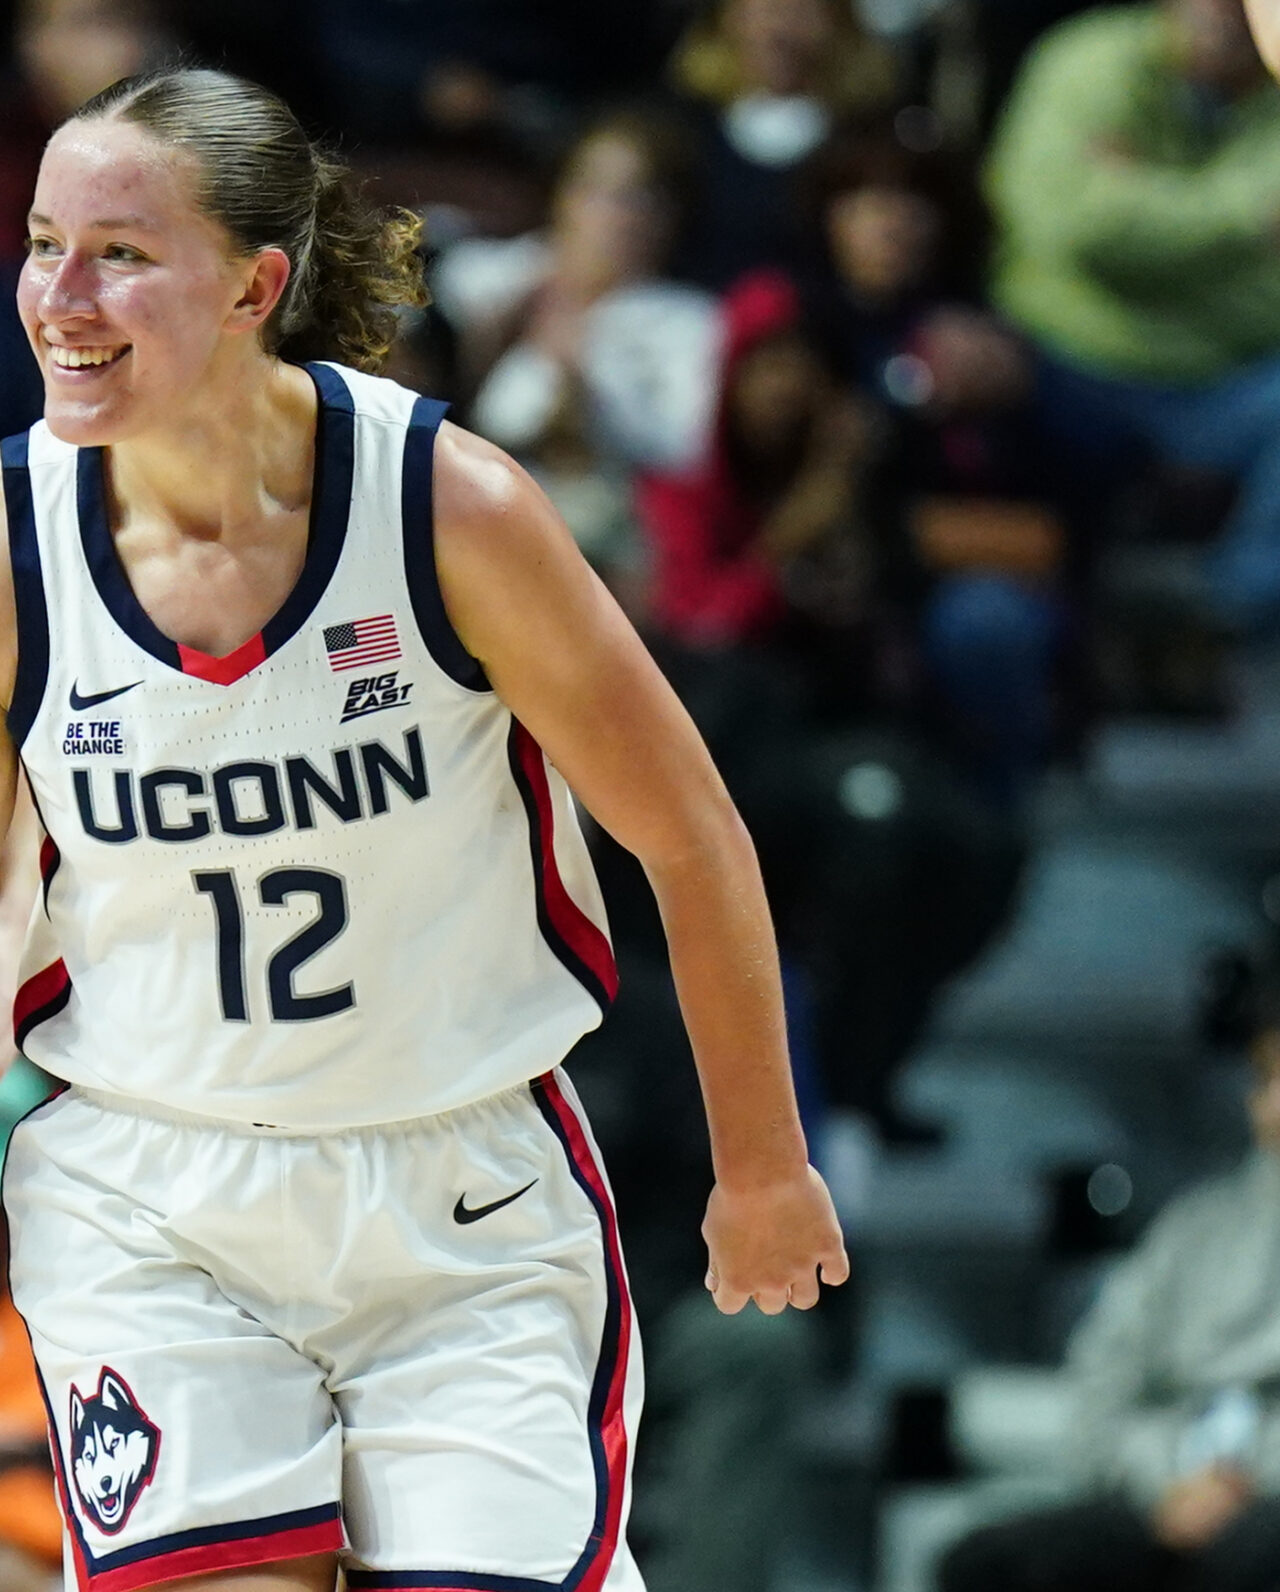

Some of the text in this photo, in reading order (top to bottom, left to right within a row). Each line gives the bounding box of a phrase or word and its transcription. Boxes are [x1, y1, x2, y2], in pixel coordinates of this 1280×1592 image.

[342, 682, 414, 715] EAST
[347, 670, 400, 698] BIG
[66, 721, 121, 739] BE THE
[62, 739, 124, 755] CHANGE
[70, 723, 431, 846] UCONN
[190, 864, 358, 1025] 12
